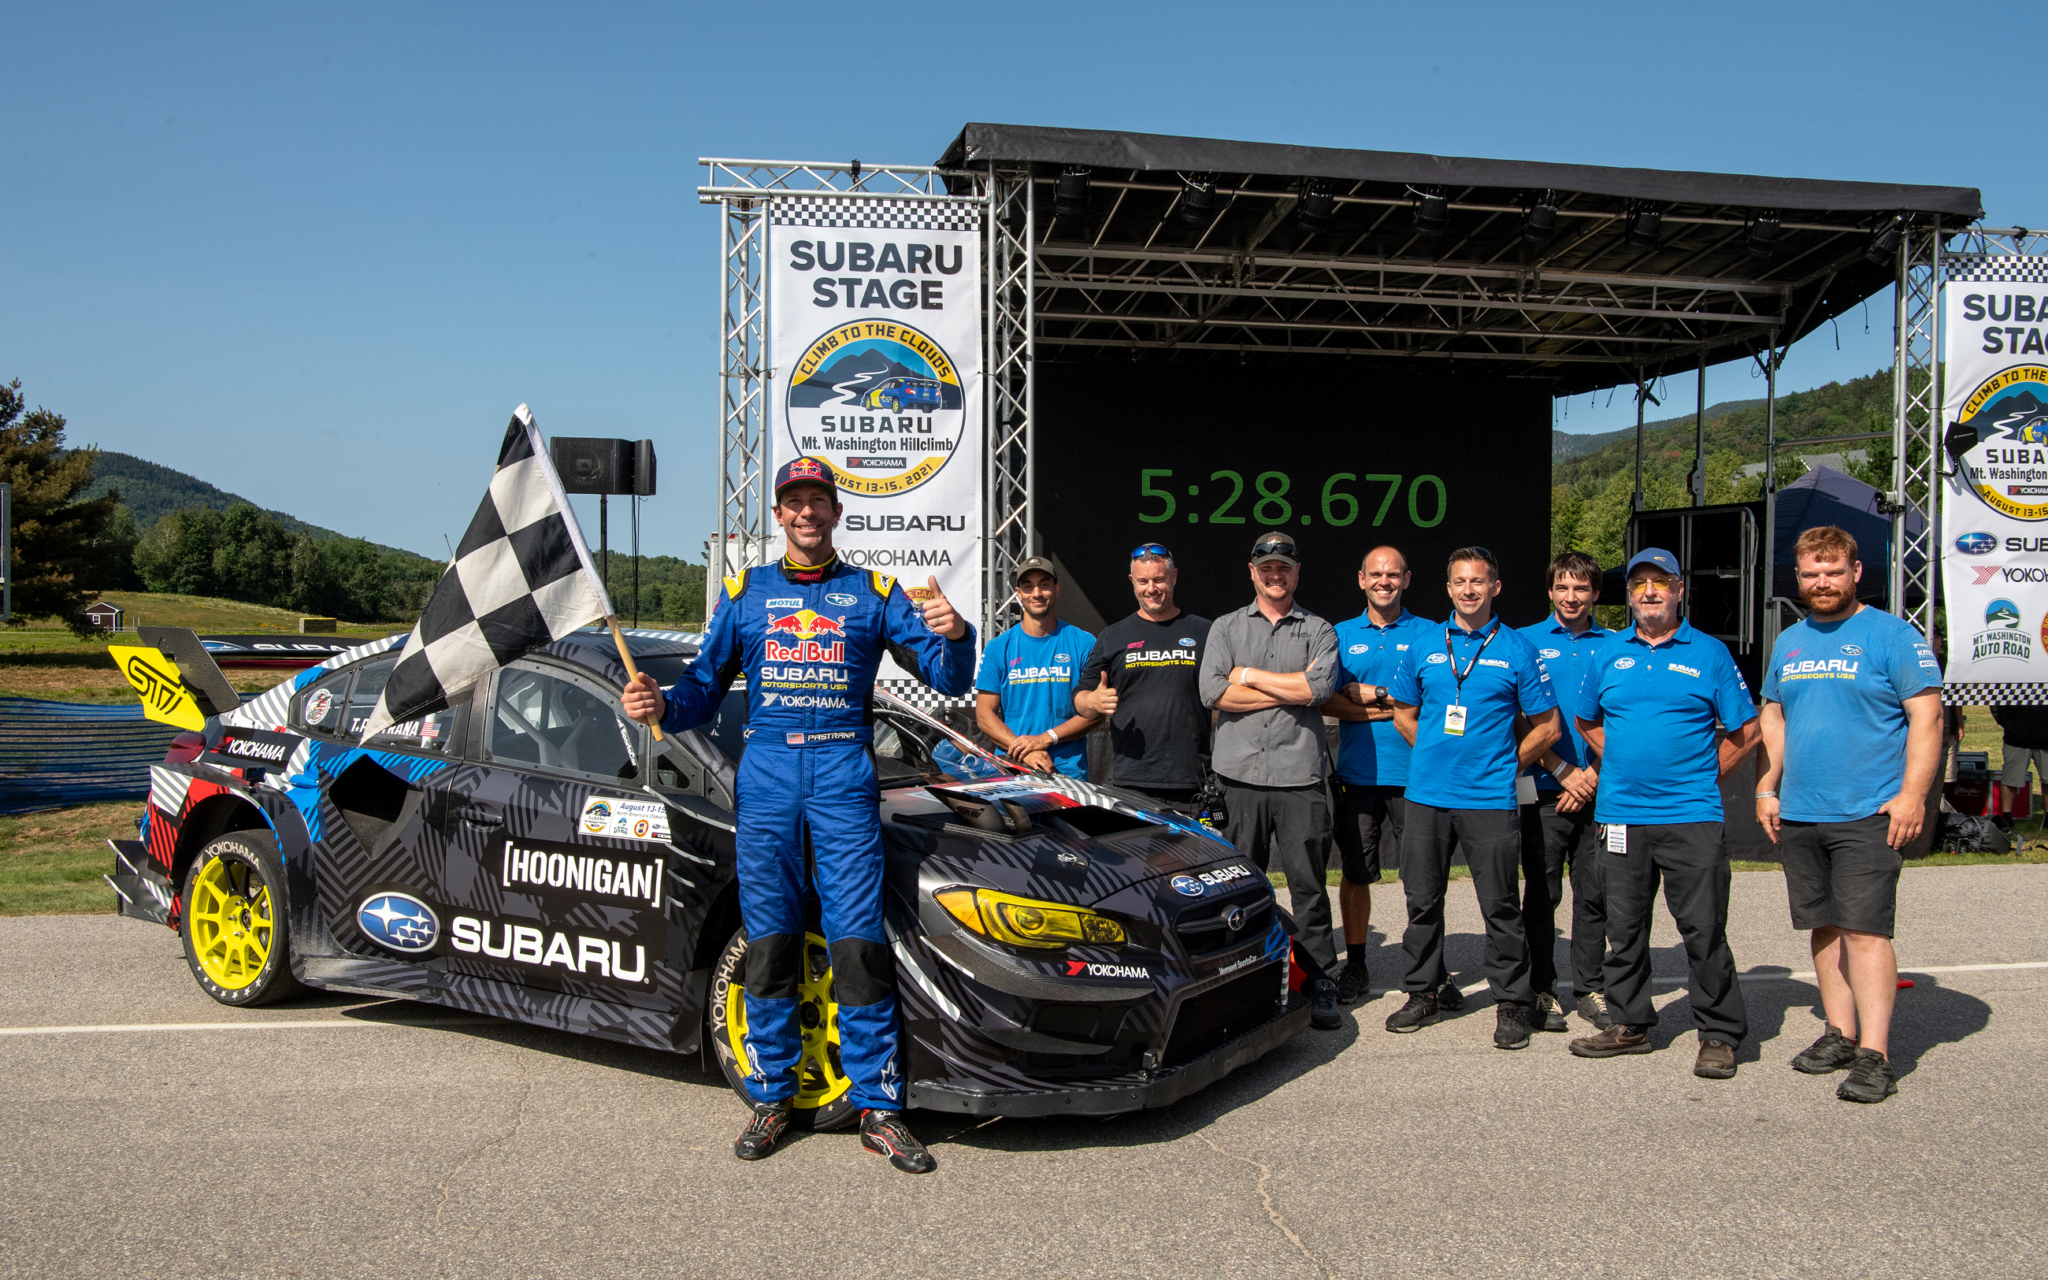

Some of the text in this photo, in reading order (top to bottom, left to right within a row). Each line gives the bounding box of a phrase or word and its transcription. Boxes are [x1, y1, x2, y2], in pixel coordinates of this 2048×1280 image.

[790, 240, 963, 275] SUBARU
[812, 277, 943, 310] STAGE
[1982, 326, 2048, 355] STA
[800, 324, 951, 379] CLIMB TO THE CLOUDS
[1965, 368, 2047, 415] CLIMB TO THE
[820, 416, 932, 433] SUBARU
[801, 436, 953, 454] Mt. Washington Hillclimb
[861, 459, 904, 467] YOKOHAMA
[1986, 449, 2048, 464] SUBA
[790, 469, 822, 479] Red Bull
[832, 463, 933, 493] GUST 13-15, 2021
[1970, 467, 2048, 482] Mt. Washington
[1138, 468, 1447, 528] 5:28.670
[1983, 490, 2021, 515] AUGUST
[845, 515, 966, 532] SUBARU
[841, 549, 952, 567] YOKOHAMA
[1973, 632, 2032, 646] MT. WASHINGTON
[765, 640, 845, 664] Red Bull
[1125, 650, 1196, 663] SUBARU
[1972, 642, 2031, 661] AUTO ROAD
[1008, 667, 1071, 679] SUBARU
[1125, 660, 1180, 669] MOTORSPORTS
[1782, 659, 1859, 676] SUBARU
[761, 667, 848, 682] SUBARU
[761, 681, 828, 690] MOTORSPORTS
[807, 731, 856, 742] PASTRANA
[227, 739, 286, 761] YOKOHAMA
[620, 802, 645, 812] August
[205, 841, 260, 870] YOKOHAMA
[1198, 864, 1252, 886] SUBARU
[451, 916, 646, 983] SUBARU
[1087, 963, 1150, 979] YOKOHAMA
[1219, 955, 1257, 976] Vermont SportsCar
[713, 936, 748, 1032] YOKOHAM
